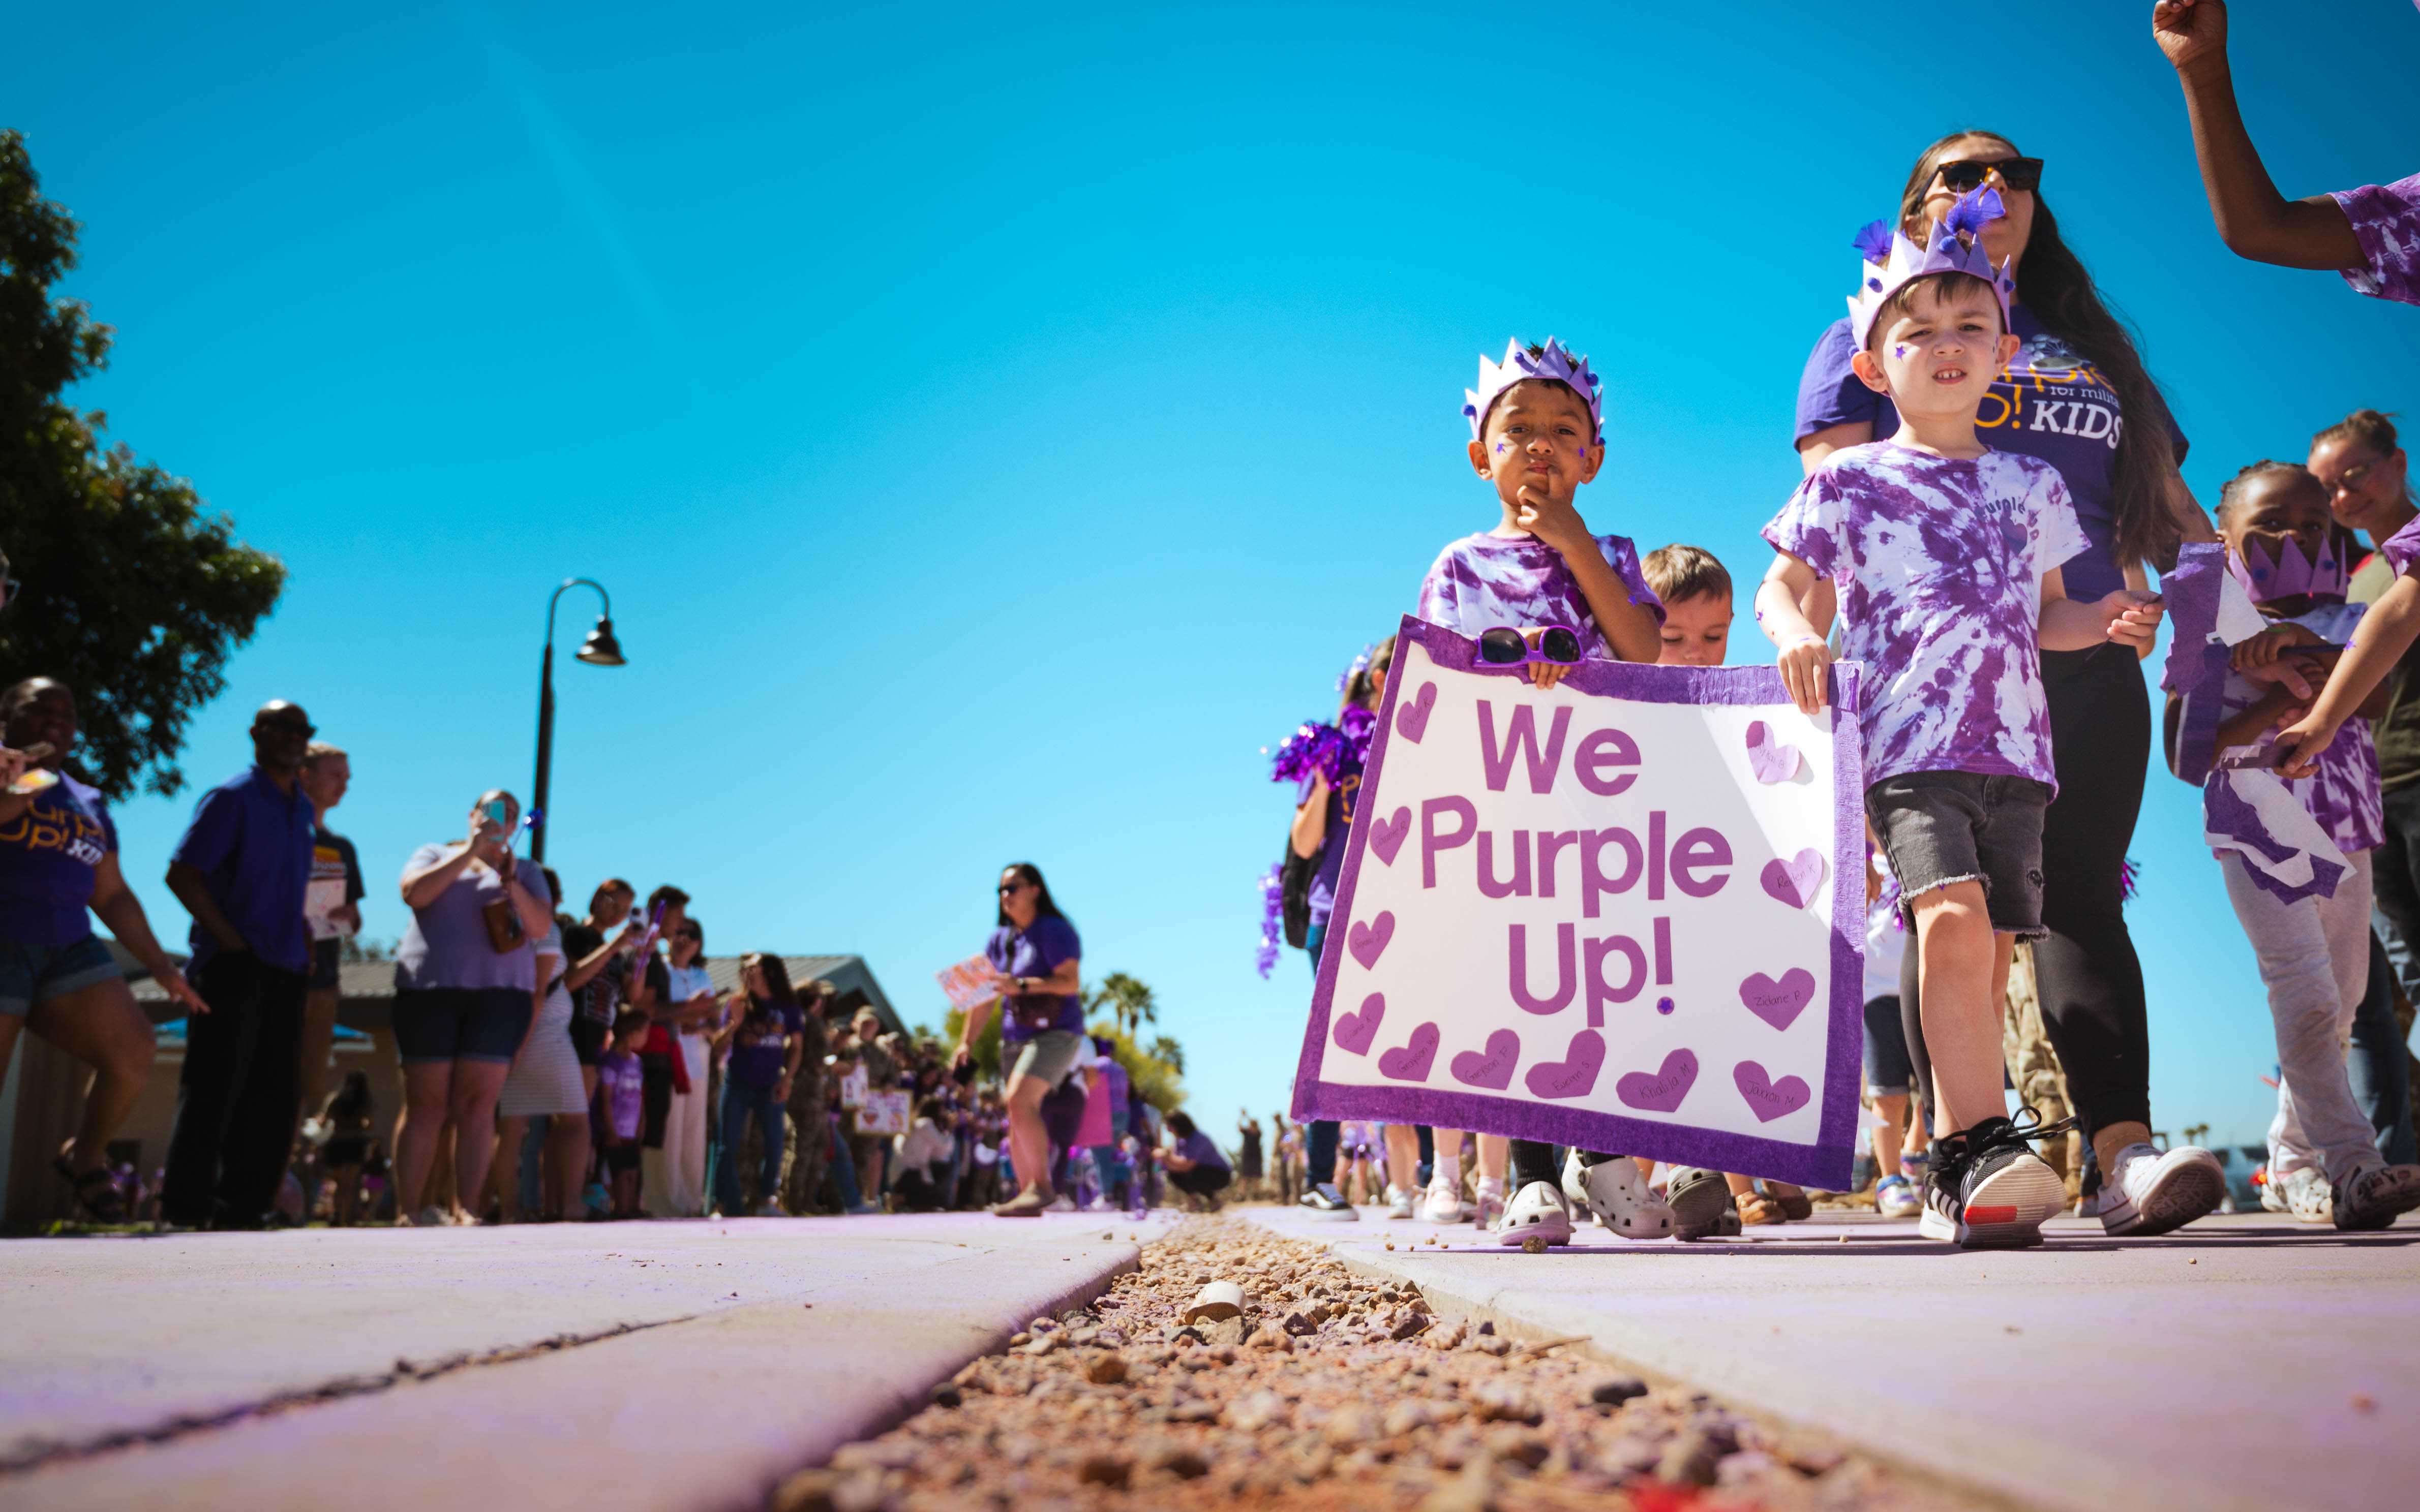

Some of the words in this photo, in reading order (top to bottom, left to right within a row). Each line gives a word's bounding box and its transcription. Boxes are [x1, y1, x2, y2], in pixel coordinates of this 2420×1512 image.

[2029, 399, 2123, 449] KIDS
[1476, 699, 1641, 796] We
[1421, 795, 1733, 918] Purple
[1508, 916, 1674, 1027] Up!
[1754, 994, 1790, 1007] Zidane
